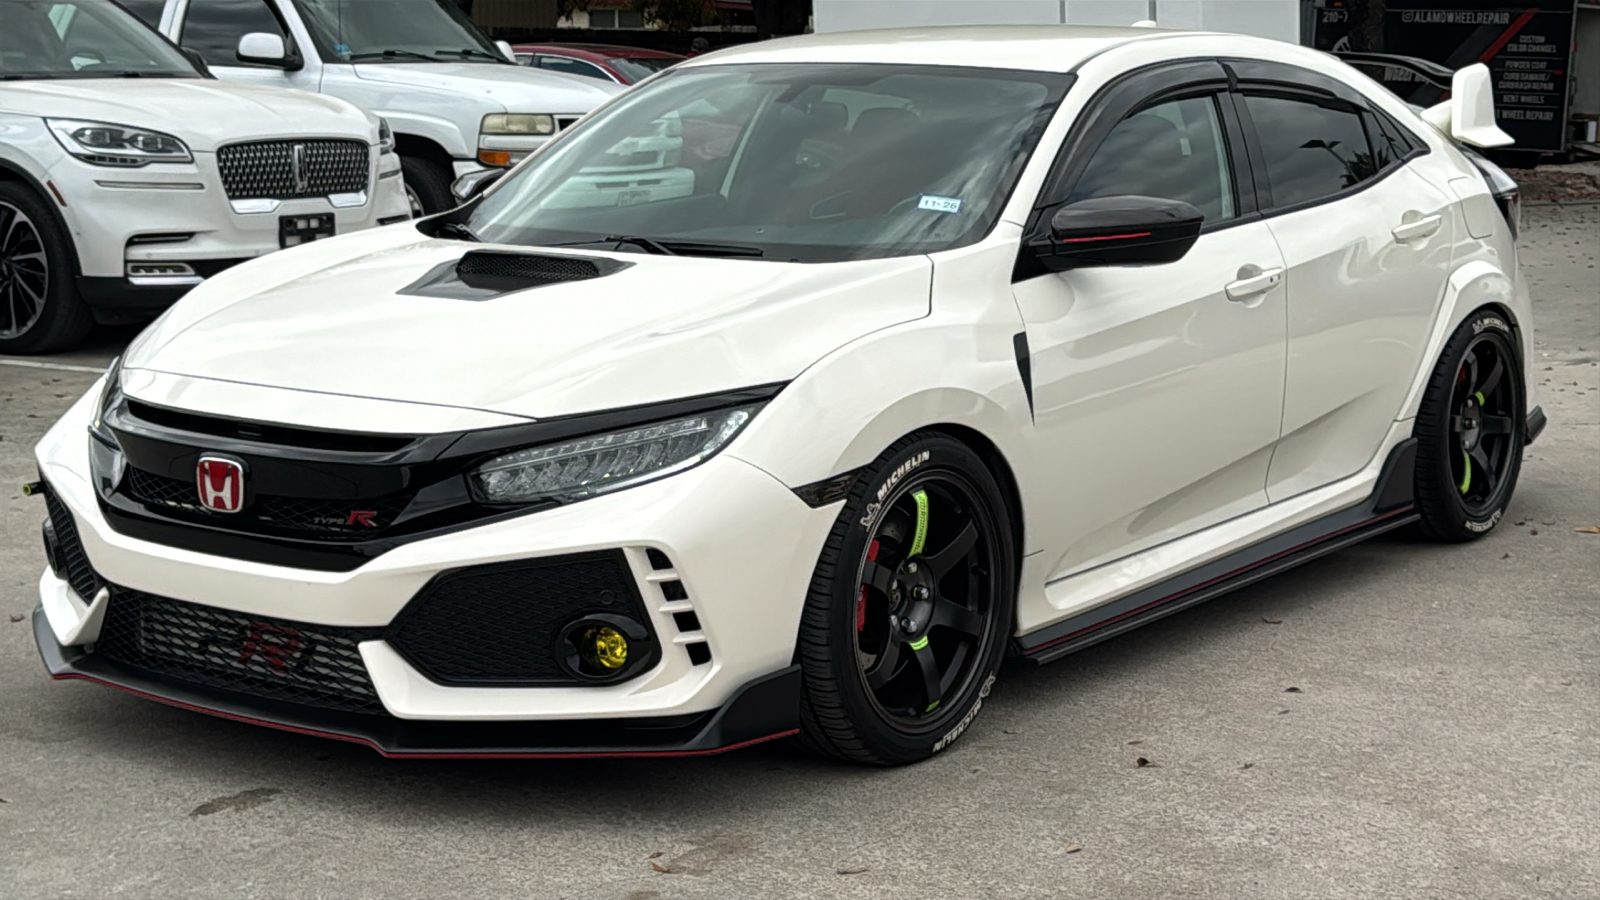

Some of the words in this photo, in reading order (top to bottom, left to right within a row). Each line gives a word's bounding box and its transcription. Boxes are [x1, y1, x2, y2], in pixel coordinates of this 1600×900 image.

[1519, 35, 1545, 43] CUSTOM
[1507, 44, 1527, 52] COLOR
[1528, 44, 1557, 53] CHANGES
[1505, 60, 1530, 69] POWDER
[1531, 61, 1547, 69] COAT
[1520, 96, 1545, 104] WHEELS
[1502, 110, 1525, 120] WHEEL
[924, 199, 957, 210] 11-26
[877, 449, 930, 502] MICHELIN
[313, 516, 345, 525] TYPE
[345, 510, 378, 527] R
[932, 698, 982, 753] MICHELIN
